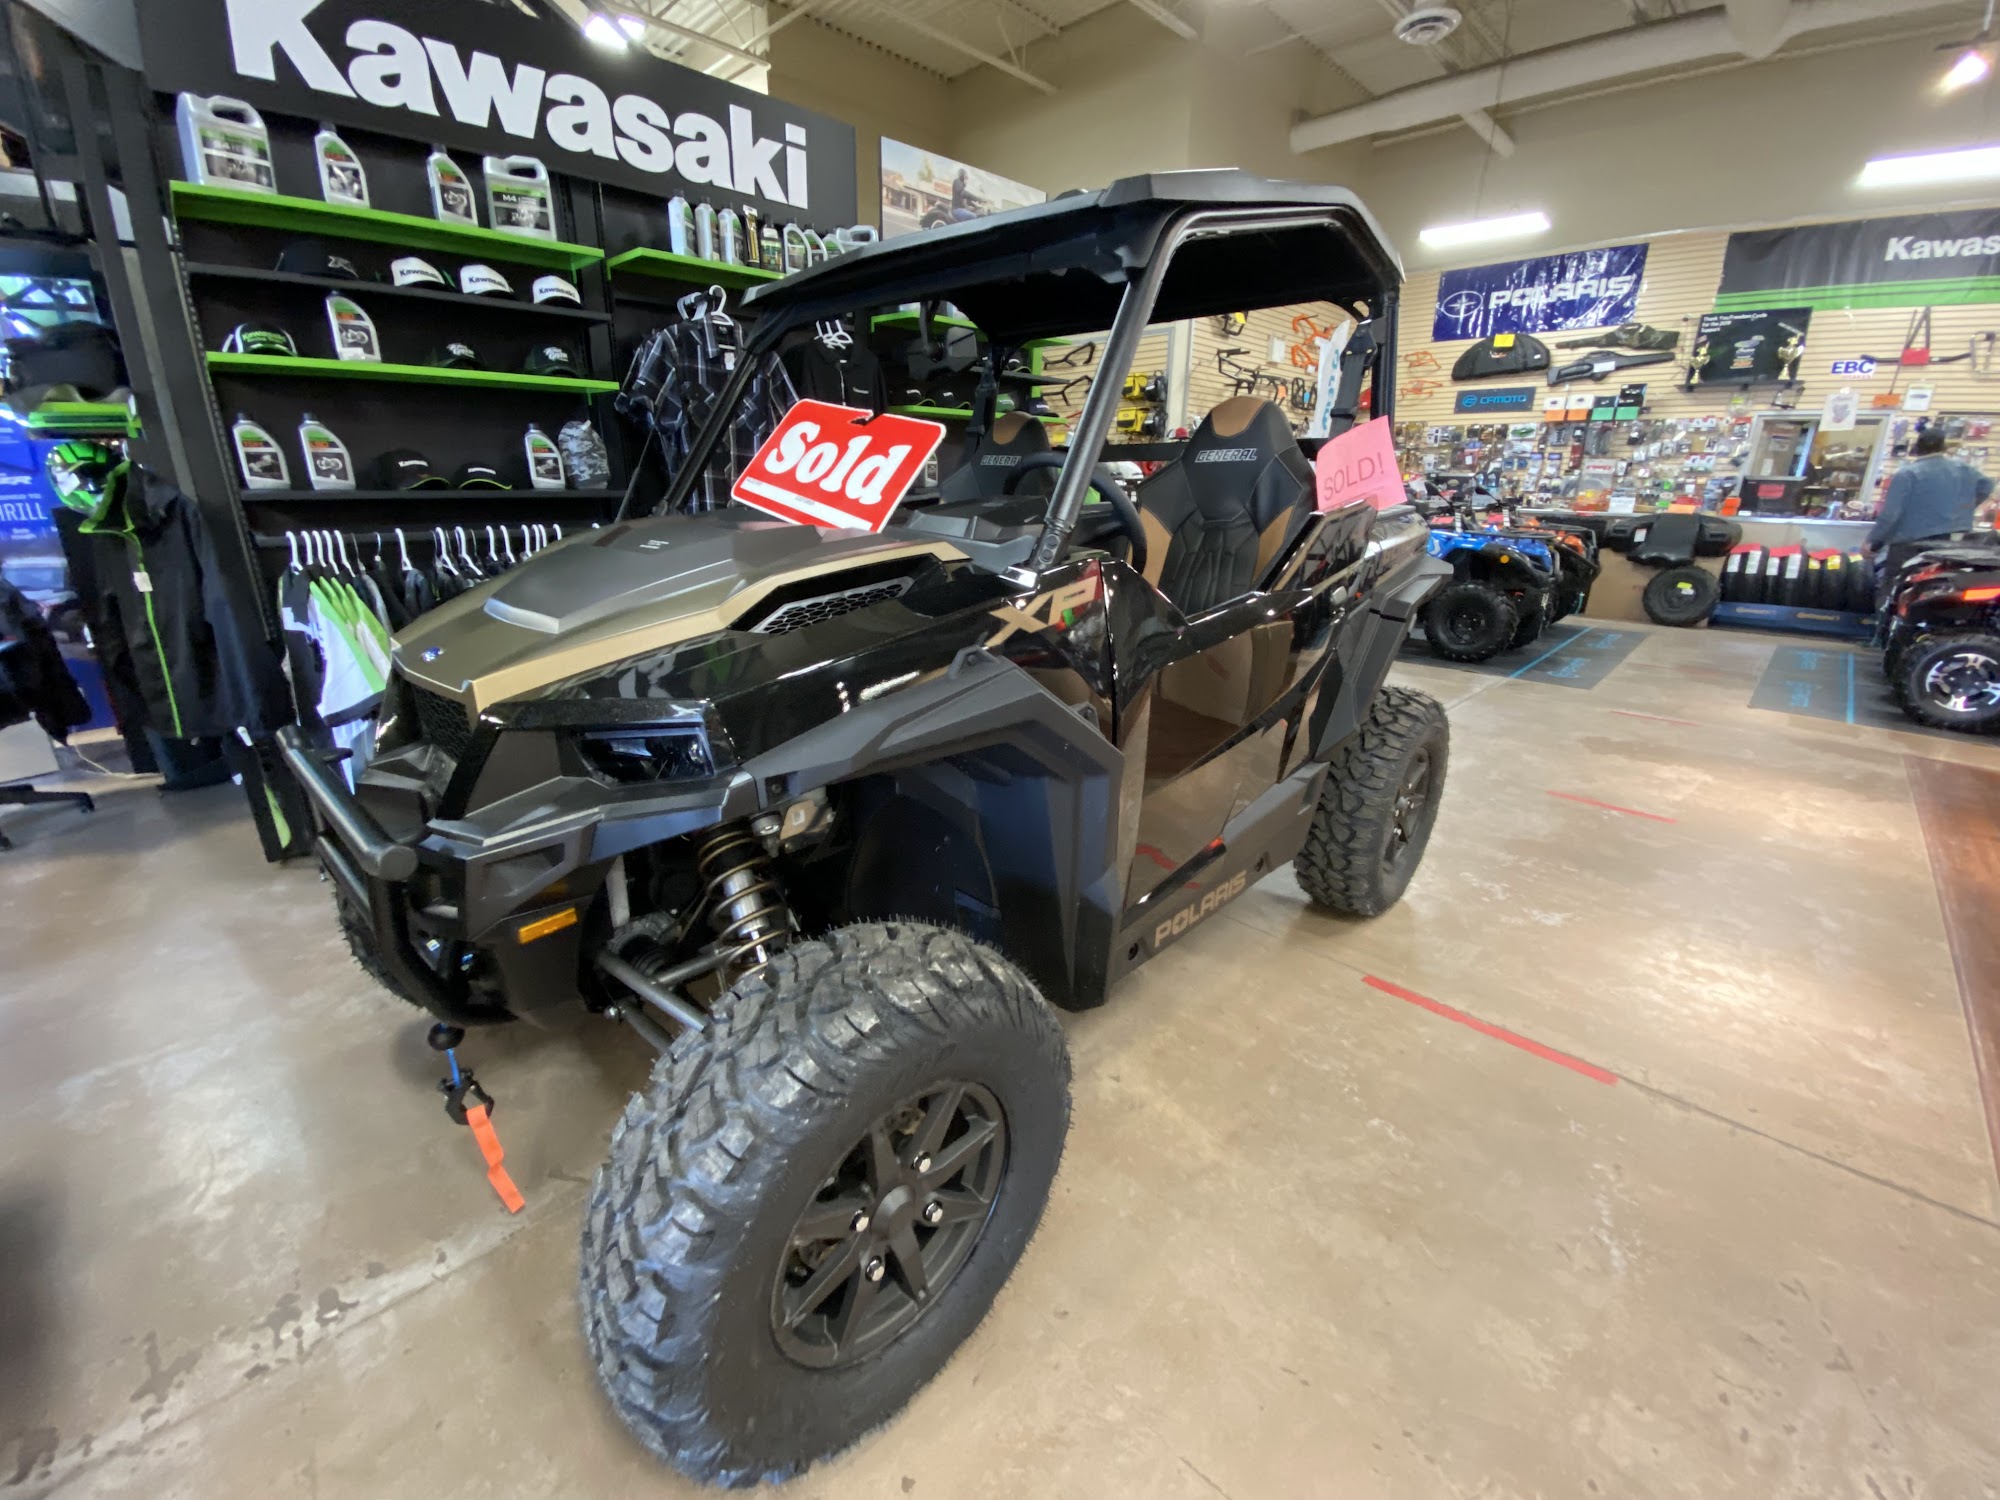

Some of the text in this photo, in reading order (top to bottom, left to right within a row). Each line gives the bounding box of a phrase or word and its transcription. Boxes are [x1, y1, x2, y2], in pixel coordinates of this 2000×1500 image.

[226, 0, 808, 210] Kawasaki
[399, 269, 440, 281] Kawasaki
[468, 276, 508, 289] Kawasaki
[539, 287, 576, 298] Kawasaki
[1489, 273, 1638, 309] POLARIS
[1831, 361, 1875, 374] EBC
[1480, 394, 1527, 405] CFMOTO
[764, 420, 912, 506] Sold
[1194, 448, 1258, 464] GENERAL
[1324, 452, 1384, 501] SOLD!
[0, 502, 48, 521] RILL
[983, 575, 1098, 648] XP
[1154, 869, 1247, 948] POLARIS
